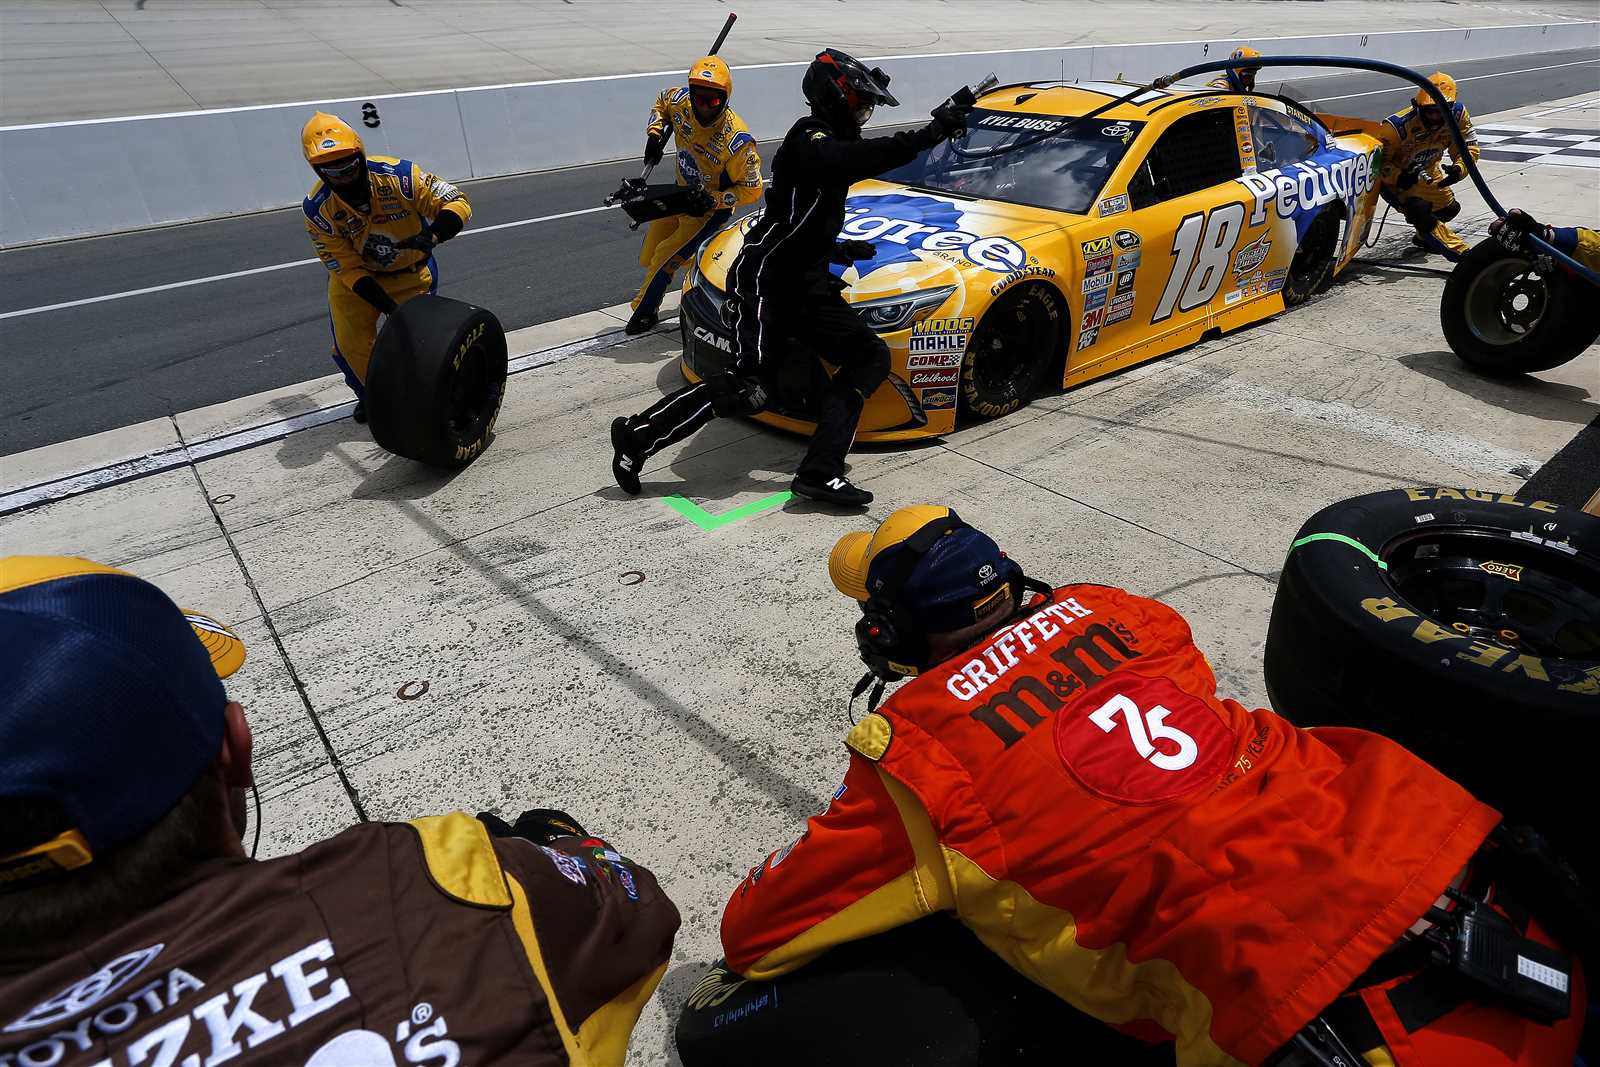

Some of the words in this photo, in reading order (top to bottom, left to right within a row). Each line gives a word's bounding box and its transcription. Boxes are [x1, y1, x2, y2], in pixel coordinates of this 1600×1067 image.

[1360, 34, 1368, 47] 10
[1203, 43, 1209, 57] 9
[361, 102, 381, 128] 8
[978, 115, 1016, 128] KYLE
[1012, 117, 1068, 132] BUSC
[1285, 105, 1313, 127] STANLEY
[933, 251, 972, 269] BRAND
[1152, 201, 1246, 323] 18
[1083, 275, 1105, 291] Mobil
[914, 318, 974, 333] MOOG
[1081, 308, 1104, 331] 3M
[910, 335, 965, 351] MAHLE
[910, 354, 951, 367] COMP
[912, 372, 957, 384] Edelbrock
[826, 477, 846, 490] N
[1403, 487, 1560, 513] EAGLE
[1488, 563, 1516, 575] AERO
[1360, 596, 1551, 683] YEAR
[946, 597, 1093, 701] GRIFFETH
[1088, 693, 1198, 771] 75
[1234, 754, 1252, 775] 75
[88, 938, 351, 1067] ZKE
